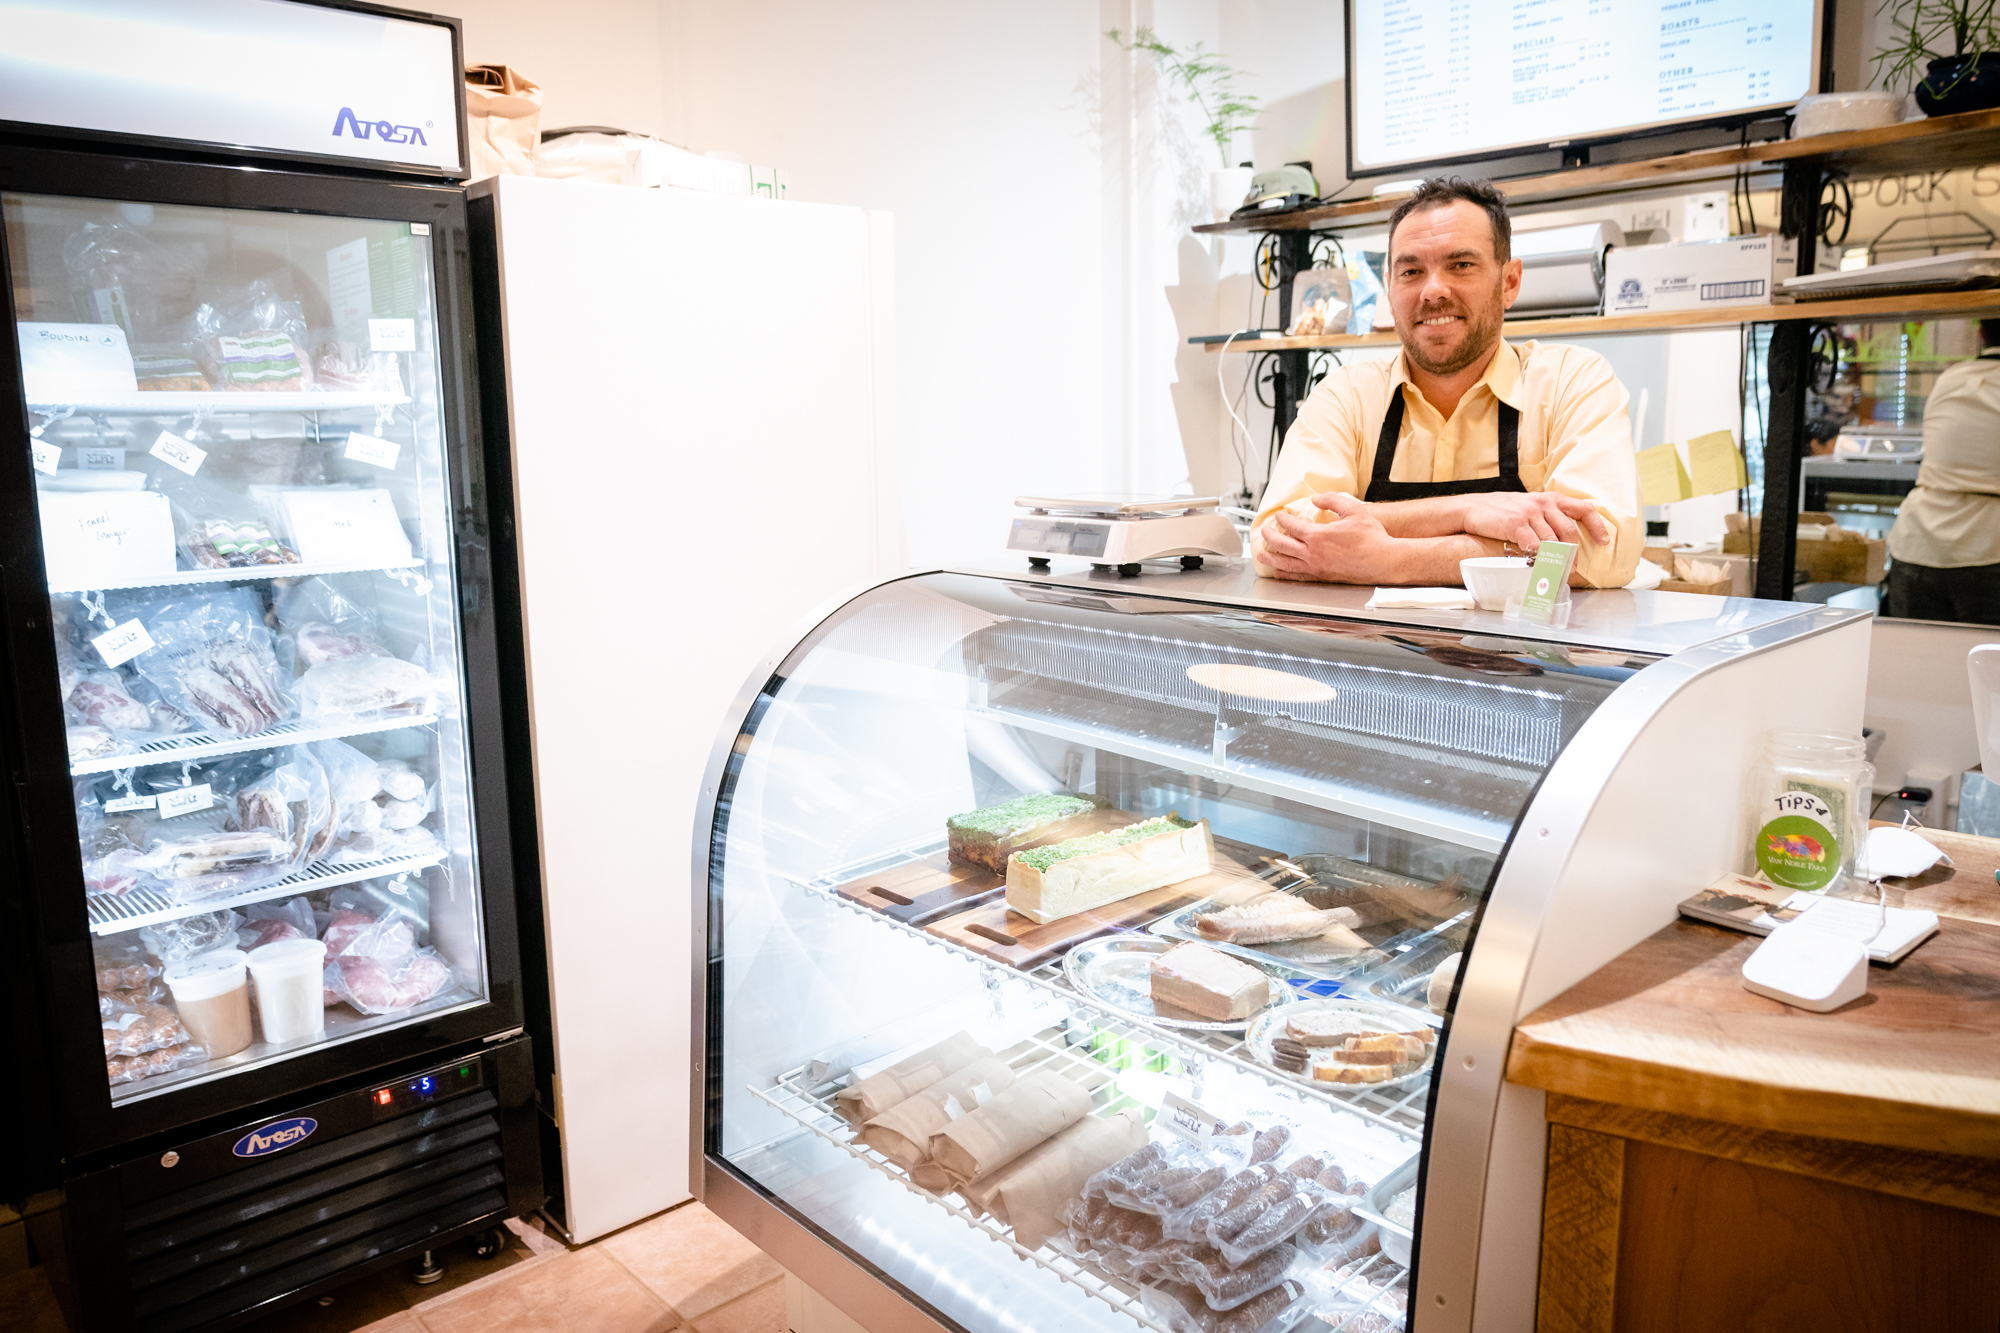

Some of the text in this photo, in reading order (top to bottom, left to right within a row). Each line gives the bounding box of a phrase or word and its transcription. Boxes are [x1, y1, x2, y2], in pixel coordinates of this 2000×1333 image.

[1660, 16, 1700, 32] ROASTS
[1513, 36, 1555, 50] SPECIALS
[1659, 66, 1694, 79] OTHER
[332, 106, 427, 147] ATOSA
[1851, 168, 1952, 208] PORK
[1538, 556, 1563, 565] CATERING
[246, 1126, 306, 1154] ATOSA
